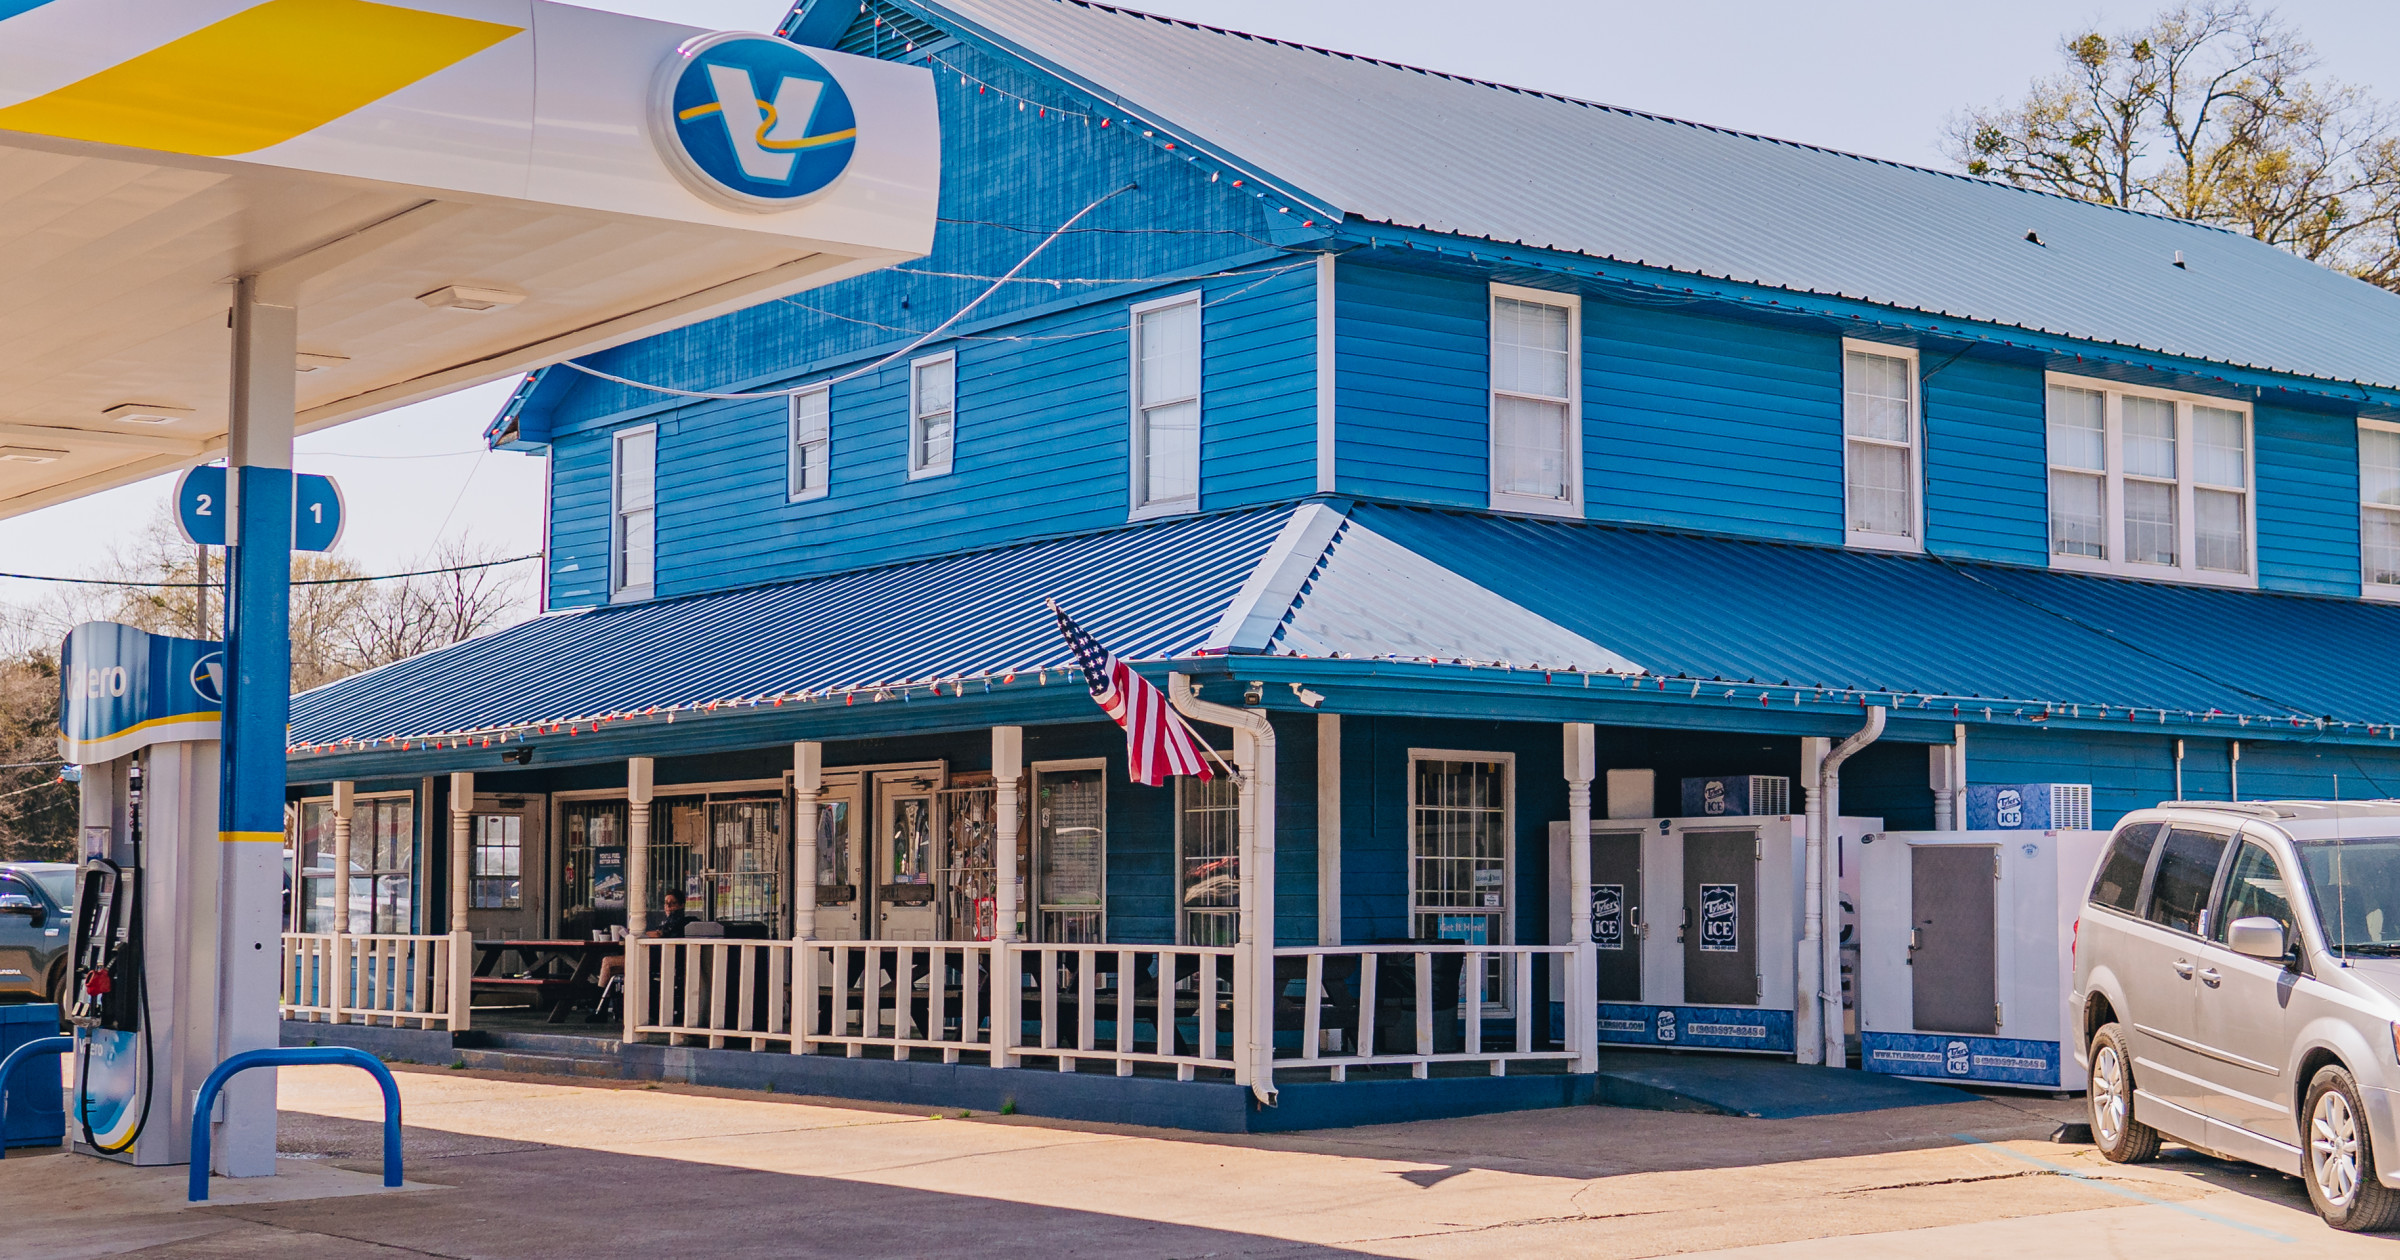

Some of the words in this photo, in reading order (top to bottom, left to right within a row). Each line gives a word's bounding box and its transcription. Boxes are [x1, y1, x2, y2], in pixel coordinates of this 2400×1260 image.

[706, 63, 825, 182] V
[195, 493, 213, 516] 2
[309, 502, 323, 524] 1
[1707, 801, 1724, 812] ICE
[2001, 812, 2020, 823] ICE
[1593, 898, 1620, 916] Tyler's
[1705, 898, 1734, 917] Tyler's
[1463, 922, 1485, 931] Hre!
[1595, 920, 1617, 934] ICE
[1708, 921, 1731, 935] ICE
[1660, 1029, 1675, 1038] ICE
[79, 1038, 103, 1056] Vero
[1951, 1061, 1968, 1071] ICE
